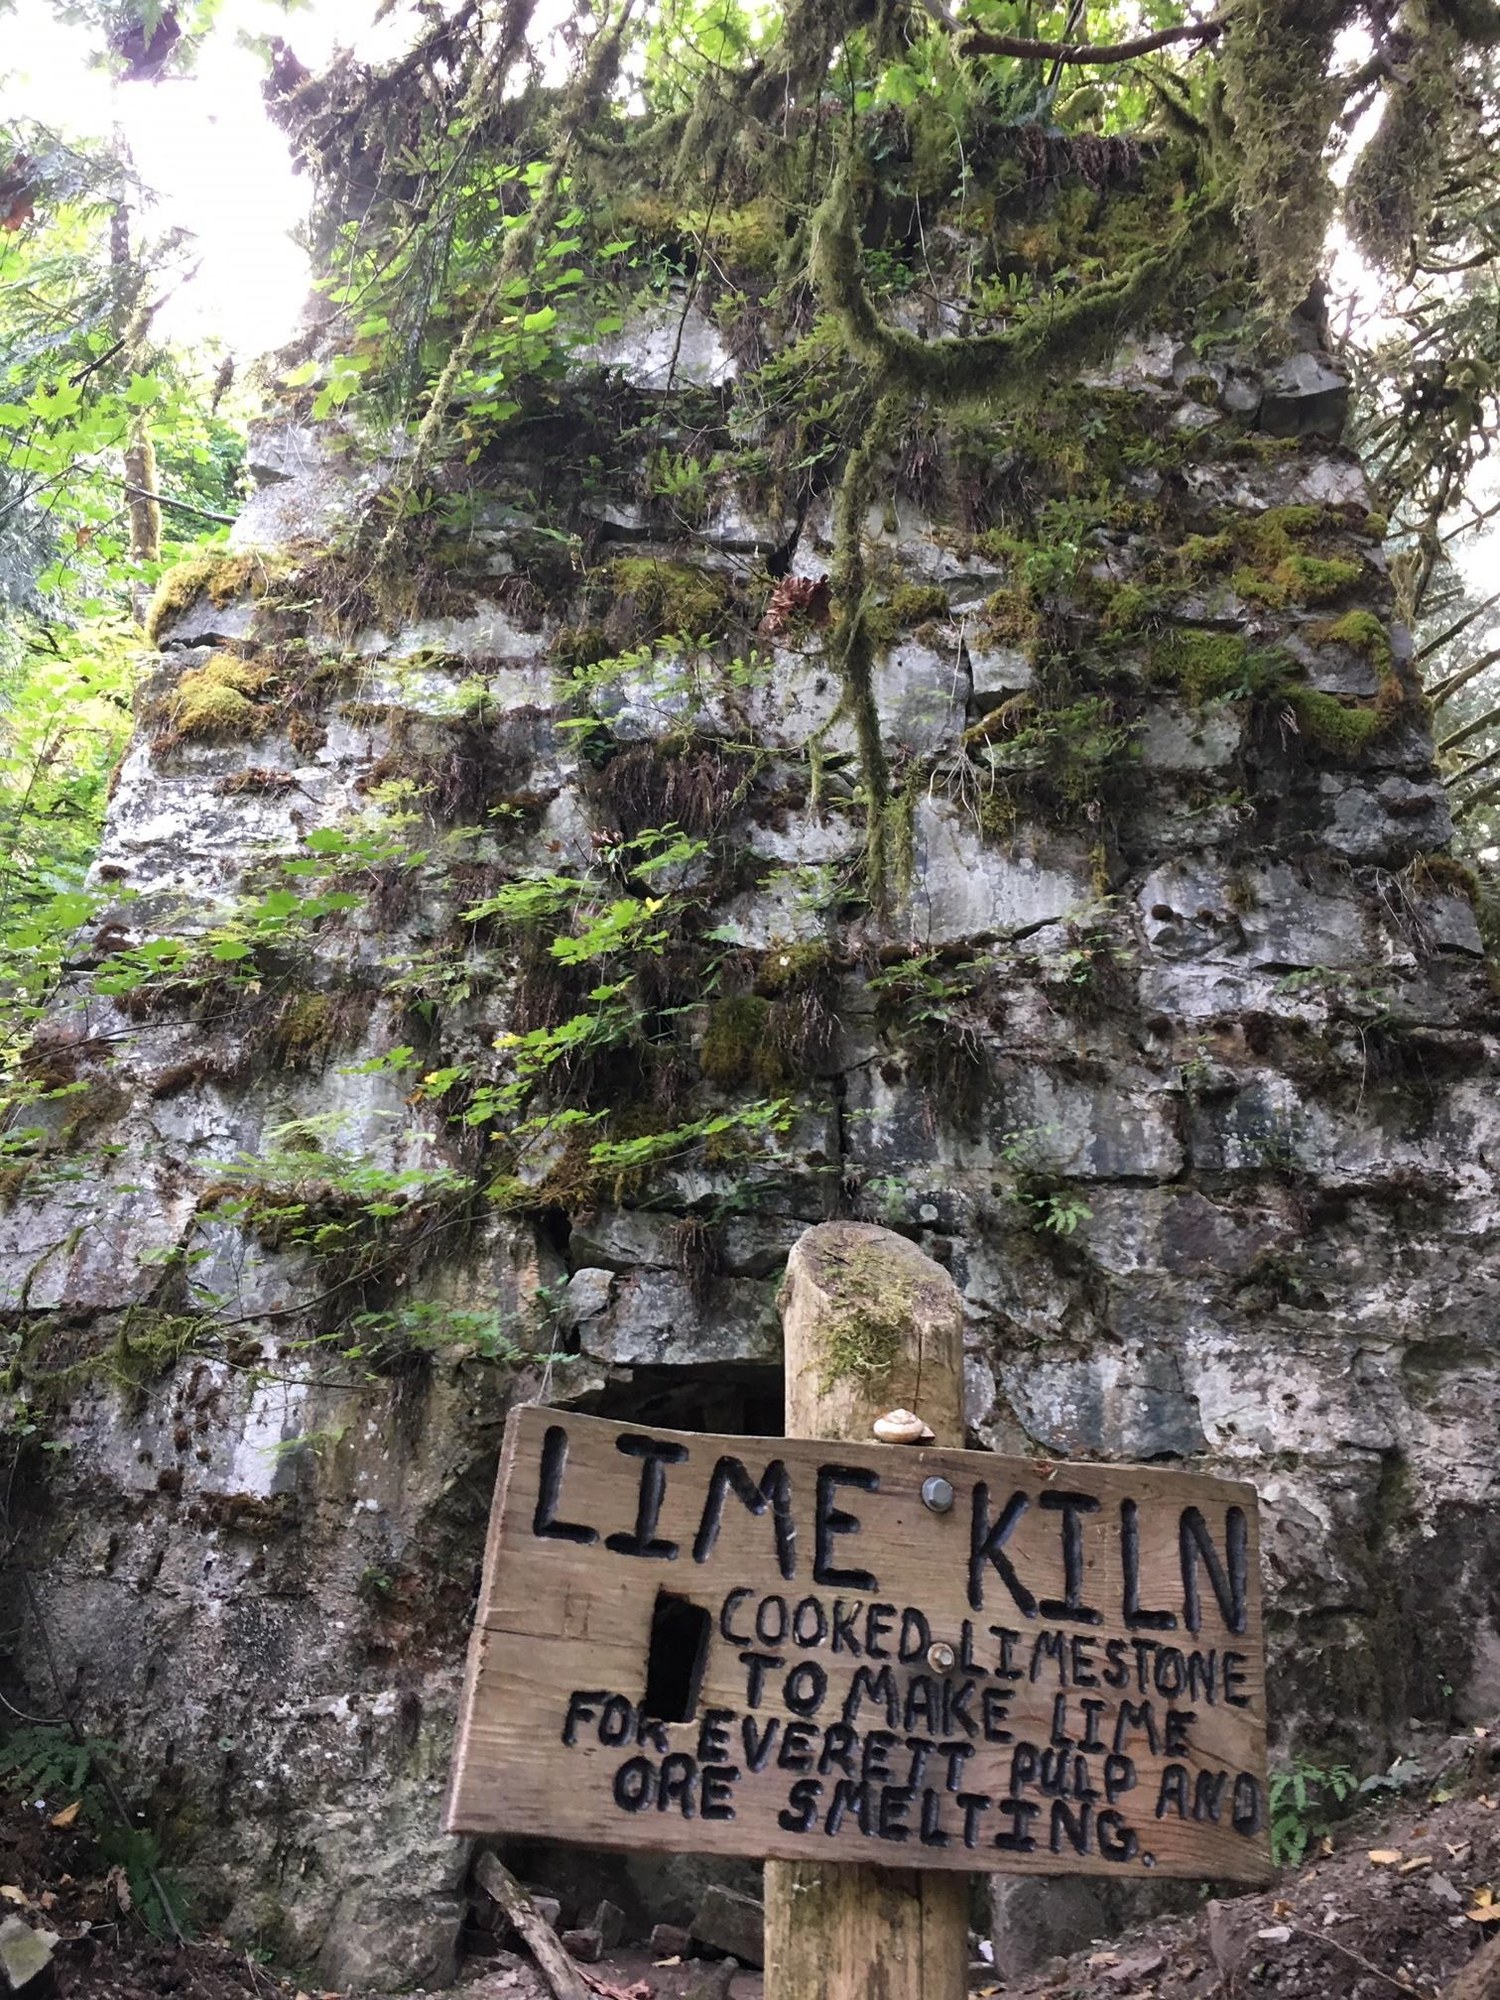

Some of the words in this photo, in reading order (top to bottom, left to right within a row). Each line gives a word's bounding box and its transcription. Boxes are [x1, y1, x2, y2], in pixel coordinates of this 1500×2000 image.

[533, 1425, 881, 1592] LIME
[967, 1481, 1248, 1635] KILN
[720, 1587, 931, 1665] COOKED
[960, 1619, 1251, 1708] LIMESTONE
[739, 1652, 828, 1718] TO
[842, 1664, 1016, 1743] MAKE
[1051, 1693, 1198, 1758] LIME
[614, 1753, 742, 1821] ORE
[697, 1709, 976, 1792] EVERETT
[1010, 1741, 1137, 1803] PULP
[1155, 1764, 1264, 1836] AND
